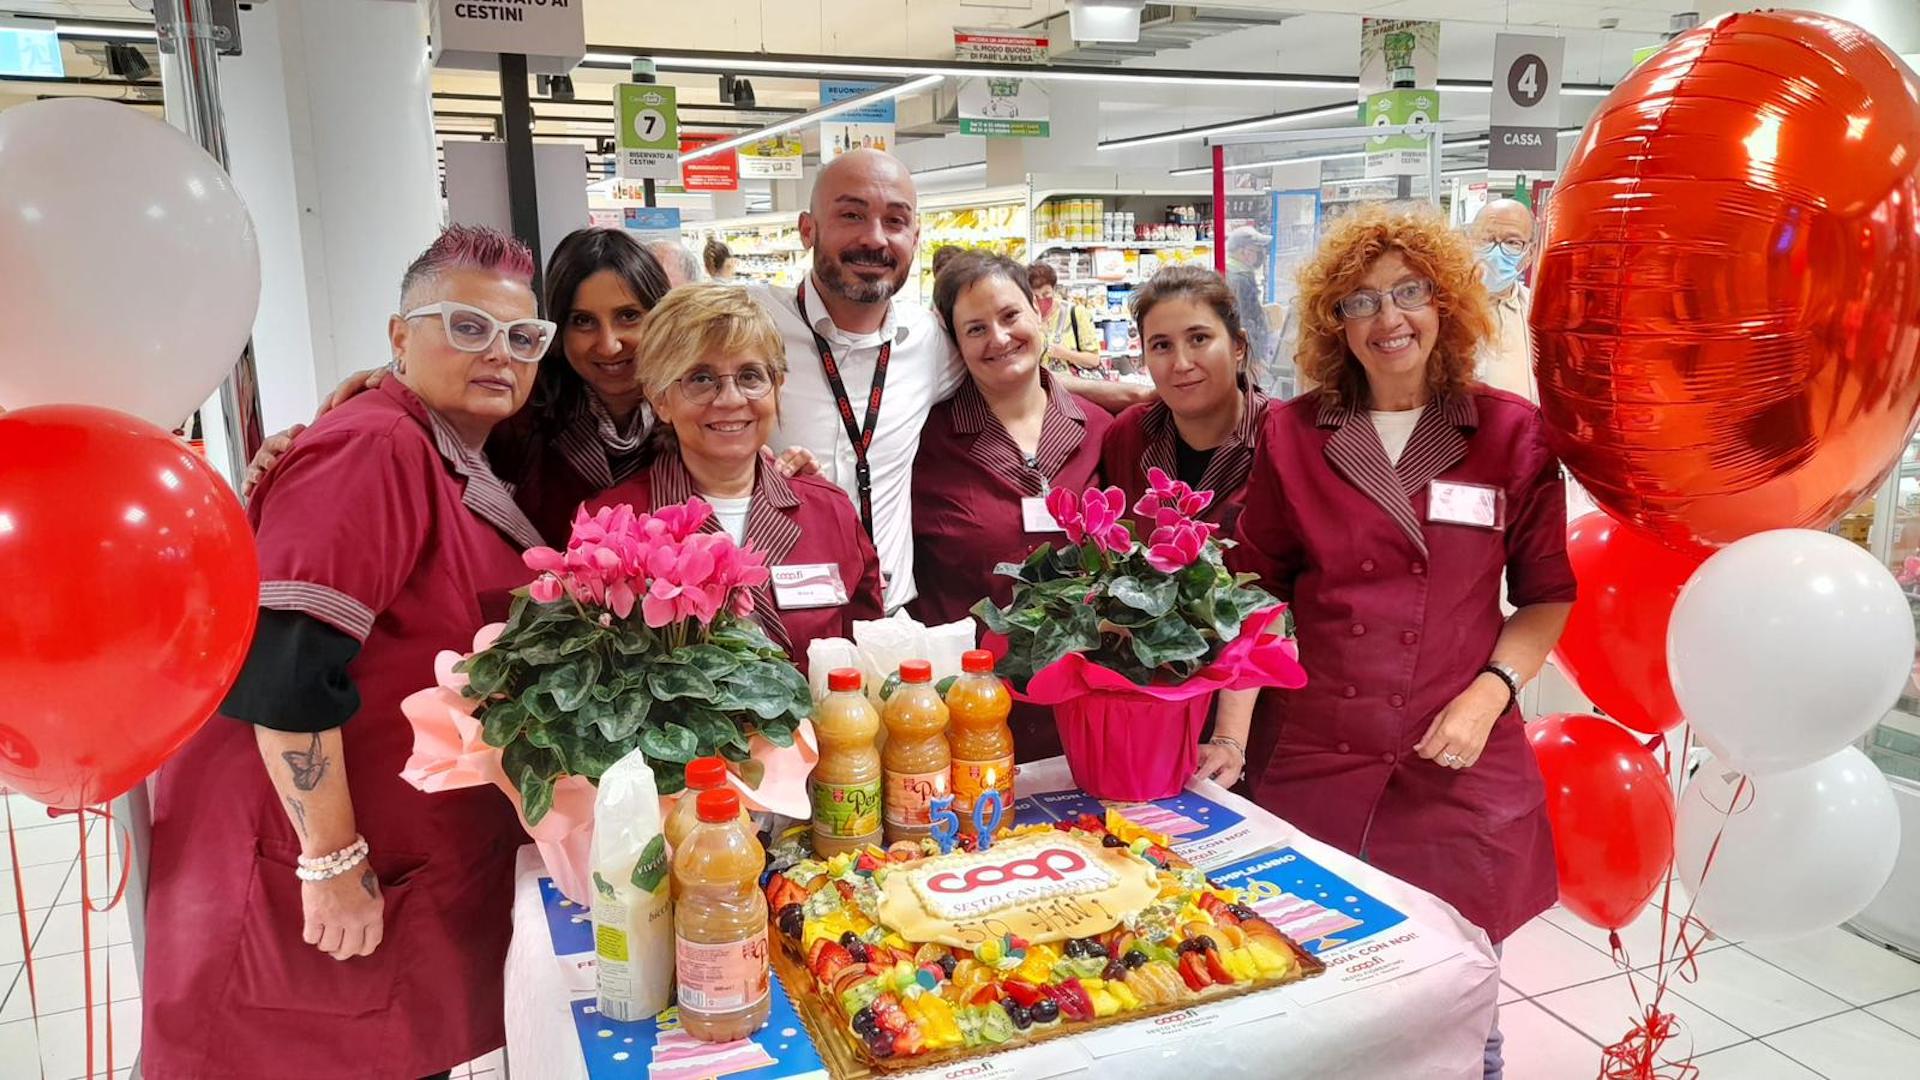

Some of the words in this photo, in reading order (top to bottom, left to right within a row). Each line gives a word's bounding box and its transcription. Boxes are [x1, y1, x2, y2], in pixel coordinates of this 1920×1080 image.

[454, 4, 523, 21] CESTINI
[981, 45, 1003, 53] MODO
[1517, 63, 1538, 98] 4
[644, 116, 656, 134] 7
[1503, 133, 1542, 145] CASSA
[927, 848, 1087, 894] coop
[1211, 854, 1297, 884] OMPLEANNO
[953, 894, 1001, 914] SESTO
[1359, 943, 1389, 956] CON
[1155, 1009, 1199, 1026] coop.fi
[945, 1061, 994, 1079] coop.fi
